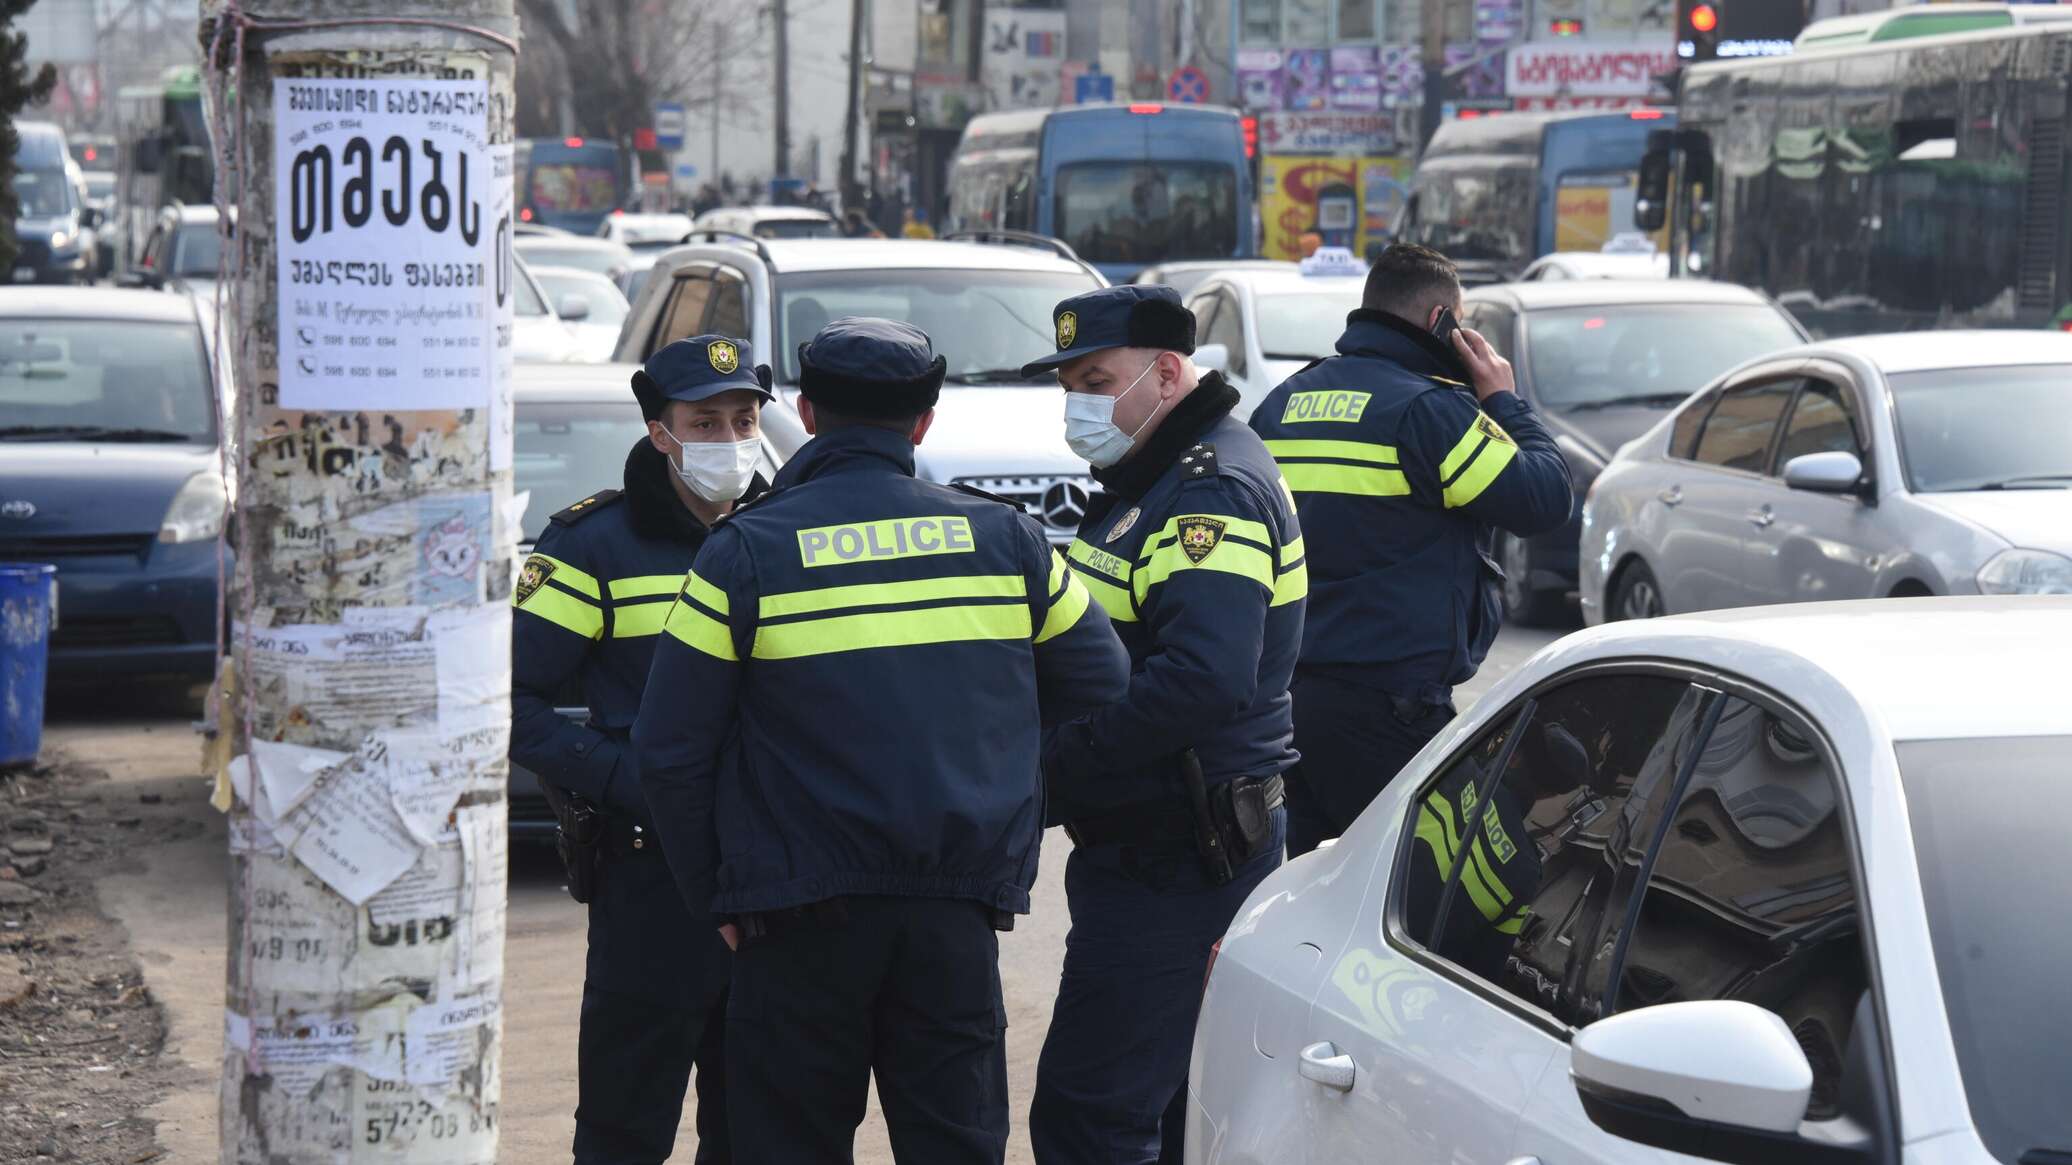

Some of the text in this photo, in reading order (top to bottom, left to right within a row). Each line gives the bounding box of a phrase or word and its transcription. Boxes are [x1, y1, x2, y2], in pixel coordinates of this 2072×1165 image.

[291, 136, 480, 247] თმებს
[290, 259, 484, 287] უმაღლეს ფასებში
[1286, 392, 1367, 419] POLICE
[800, 519, 972, 564] POLICE
[1088, 548, 1121, 577] POLICE
